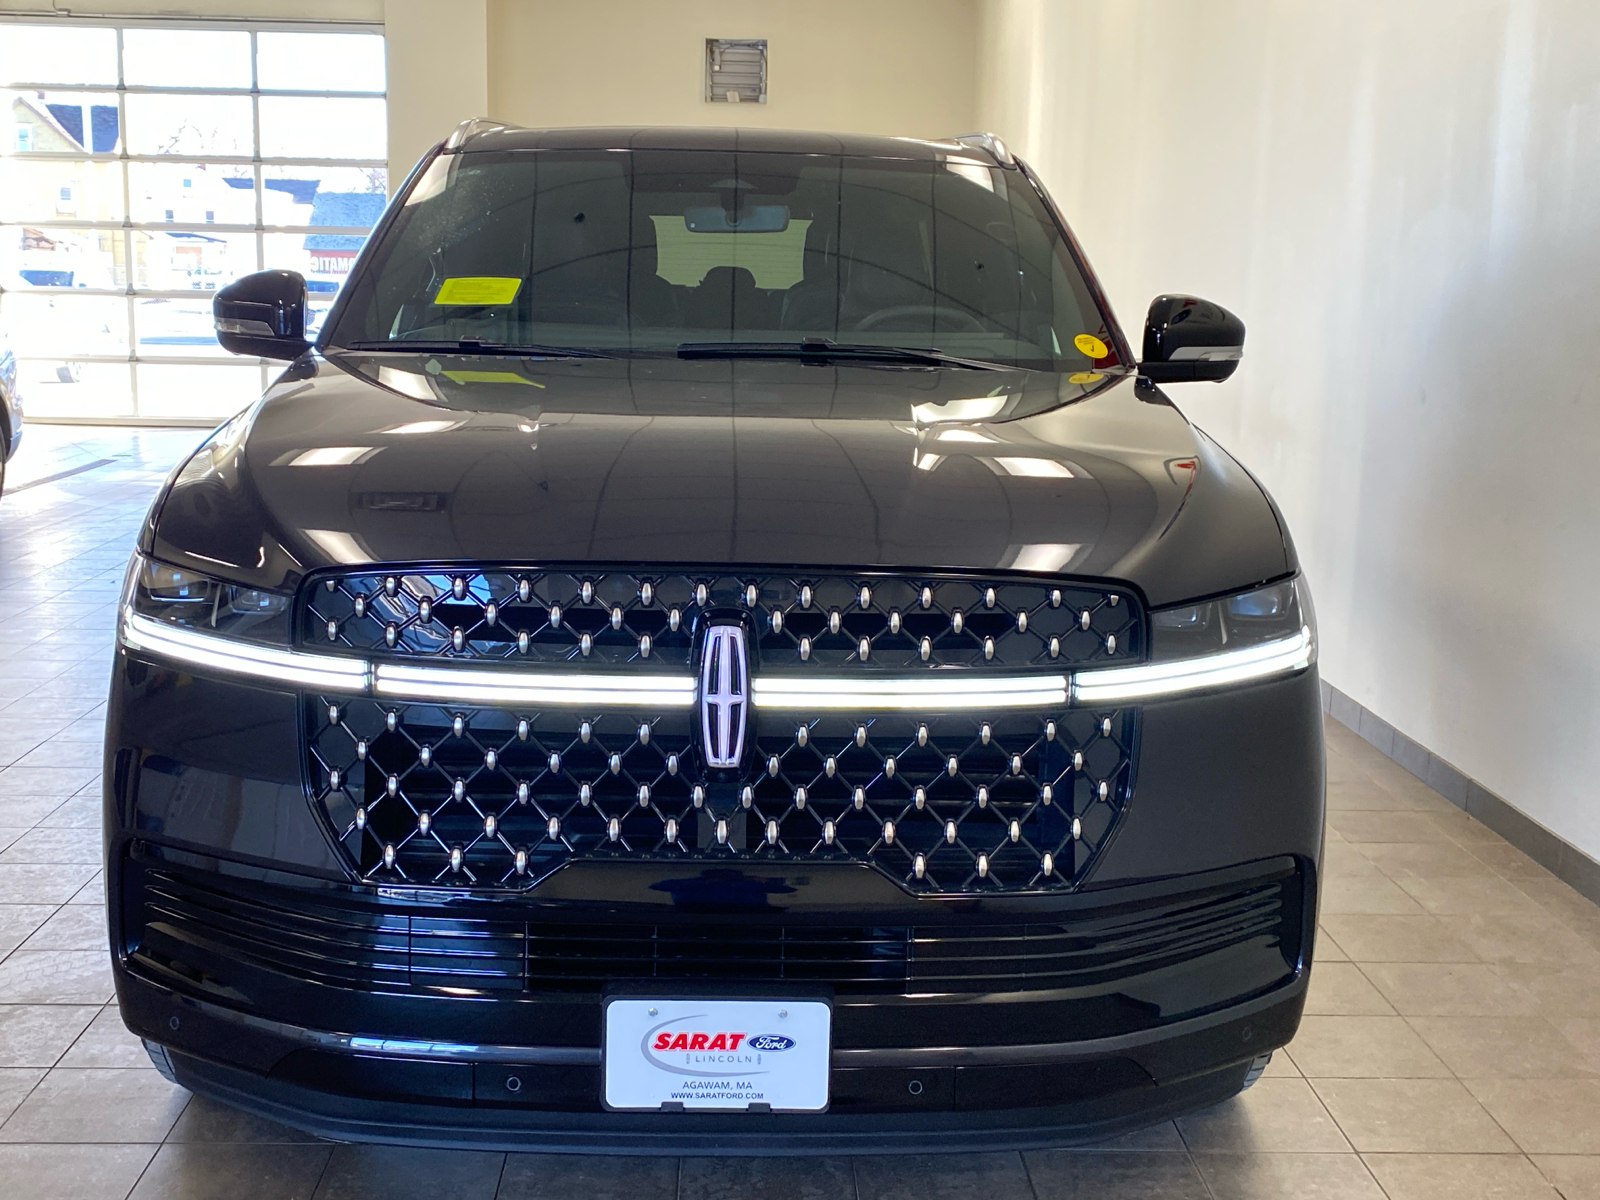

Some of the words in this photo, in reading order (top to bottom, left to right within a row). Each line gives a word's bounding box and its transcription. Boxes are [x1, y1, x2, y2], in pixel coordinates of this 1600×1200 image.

[653, 1032, 746, 1051] SARAT
[755, 1036, 788, 1049] Ford
[695, 1055, 752, 1063] LINCOLN
[682, 1081, 734, 1090] AGAWAM,
[736, 1081, 753, 1090] MA
